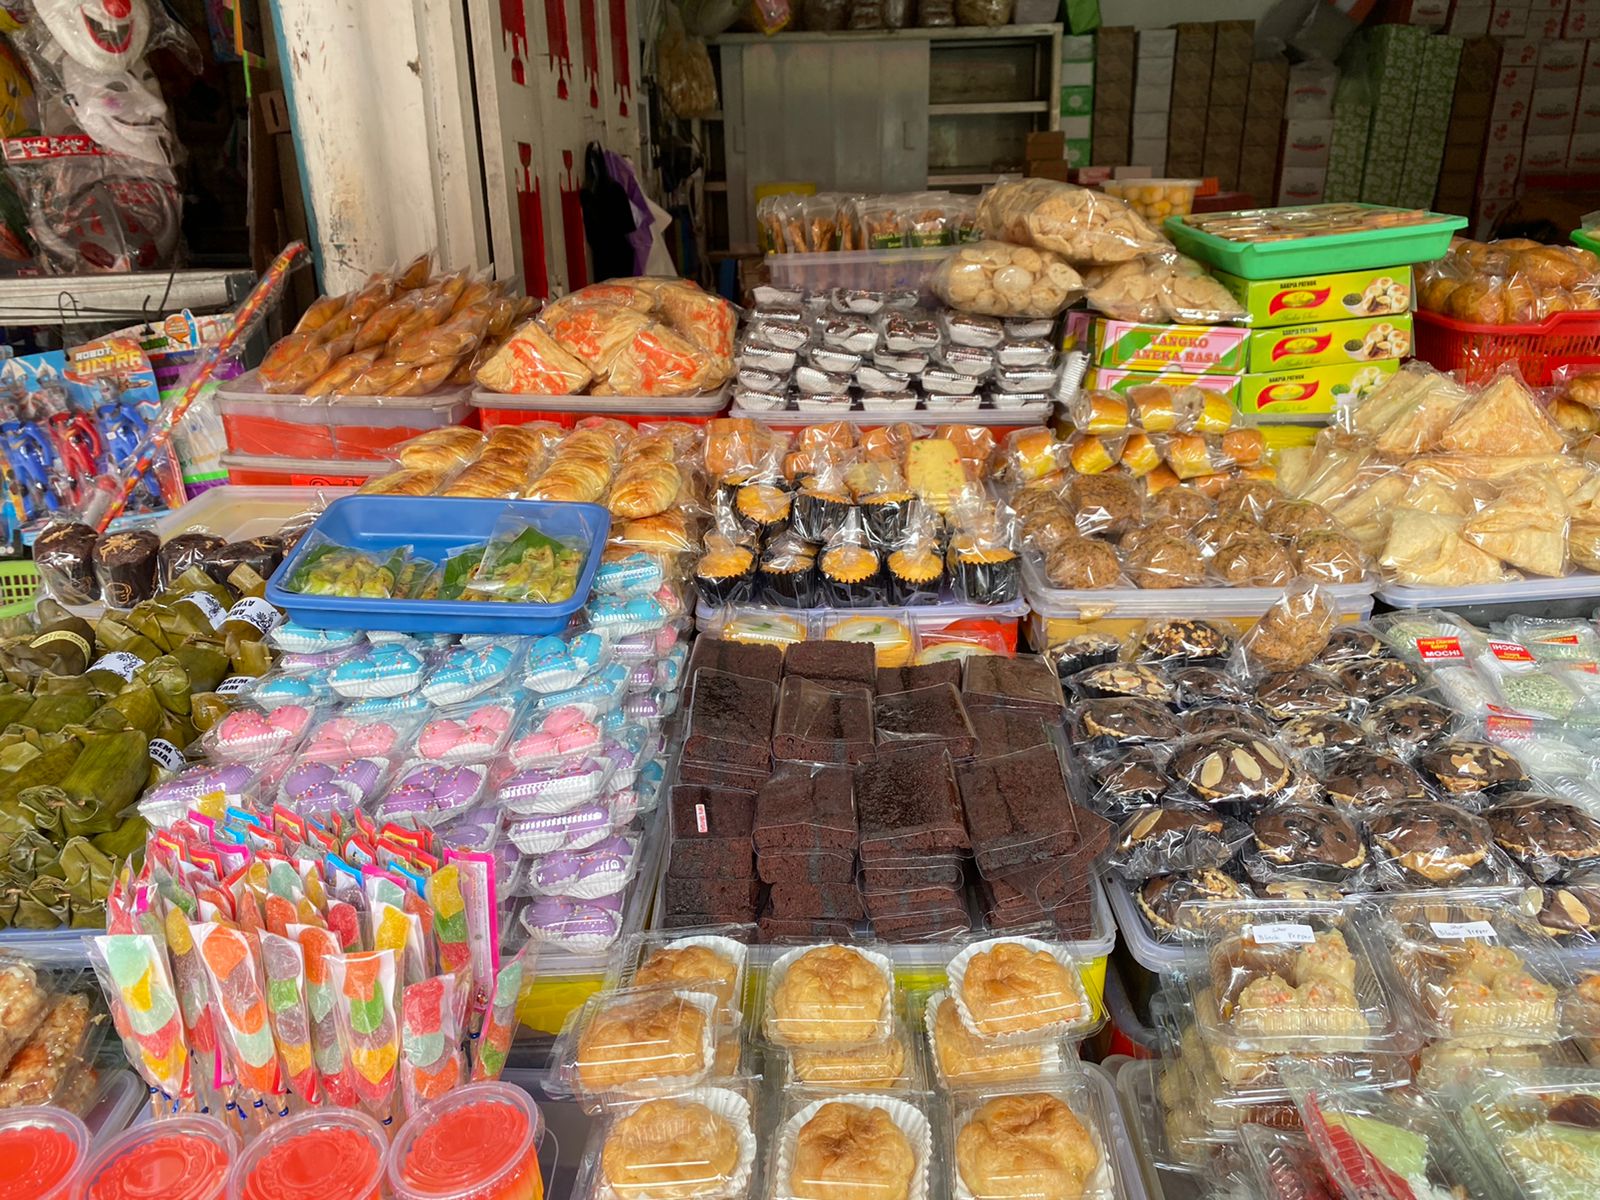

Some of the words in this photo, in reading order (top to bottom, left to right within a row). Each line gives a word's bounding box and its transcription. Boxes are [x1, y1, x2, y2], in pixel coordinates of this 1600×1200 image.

[1151, 335, 1209, 348] YANGKO
[75, 347, 112, 361] ROBOT
[1133, 350, 1182, 362] ANEKA
[1185, 352, 1222, 363] RASA
[76, 351, 143, 376] ULTRA
[1492, 643, 1524, 652] MOCHI
